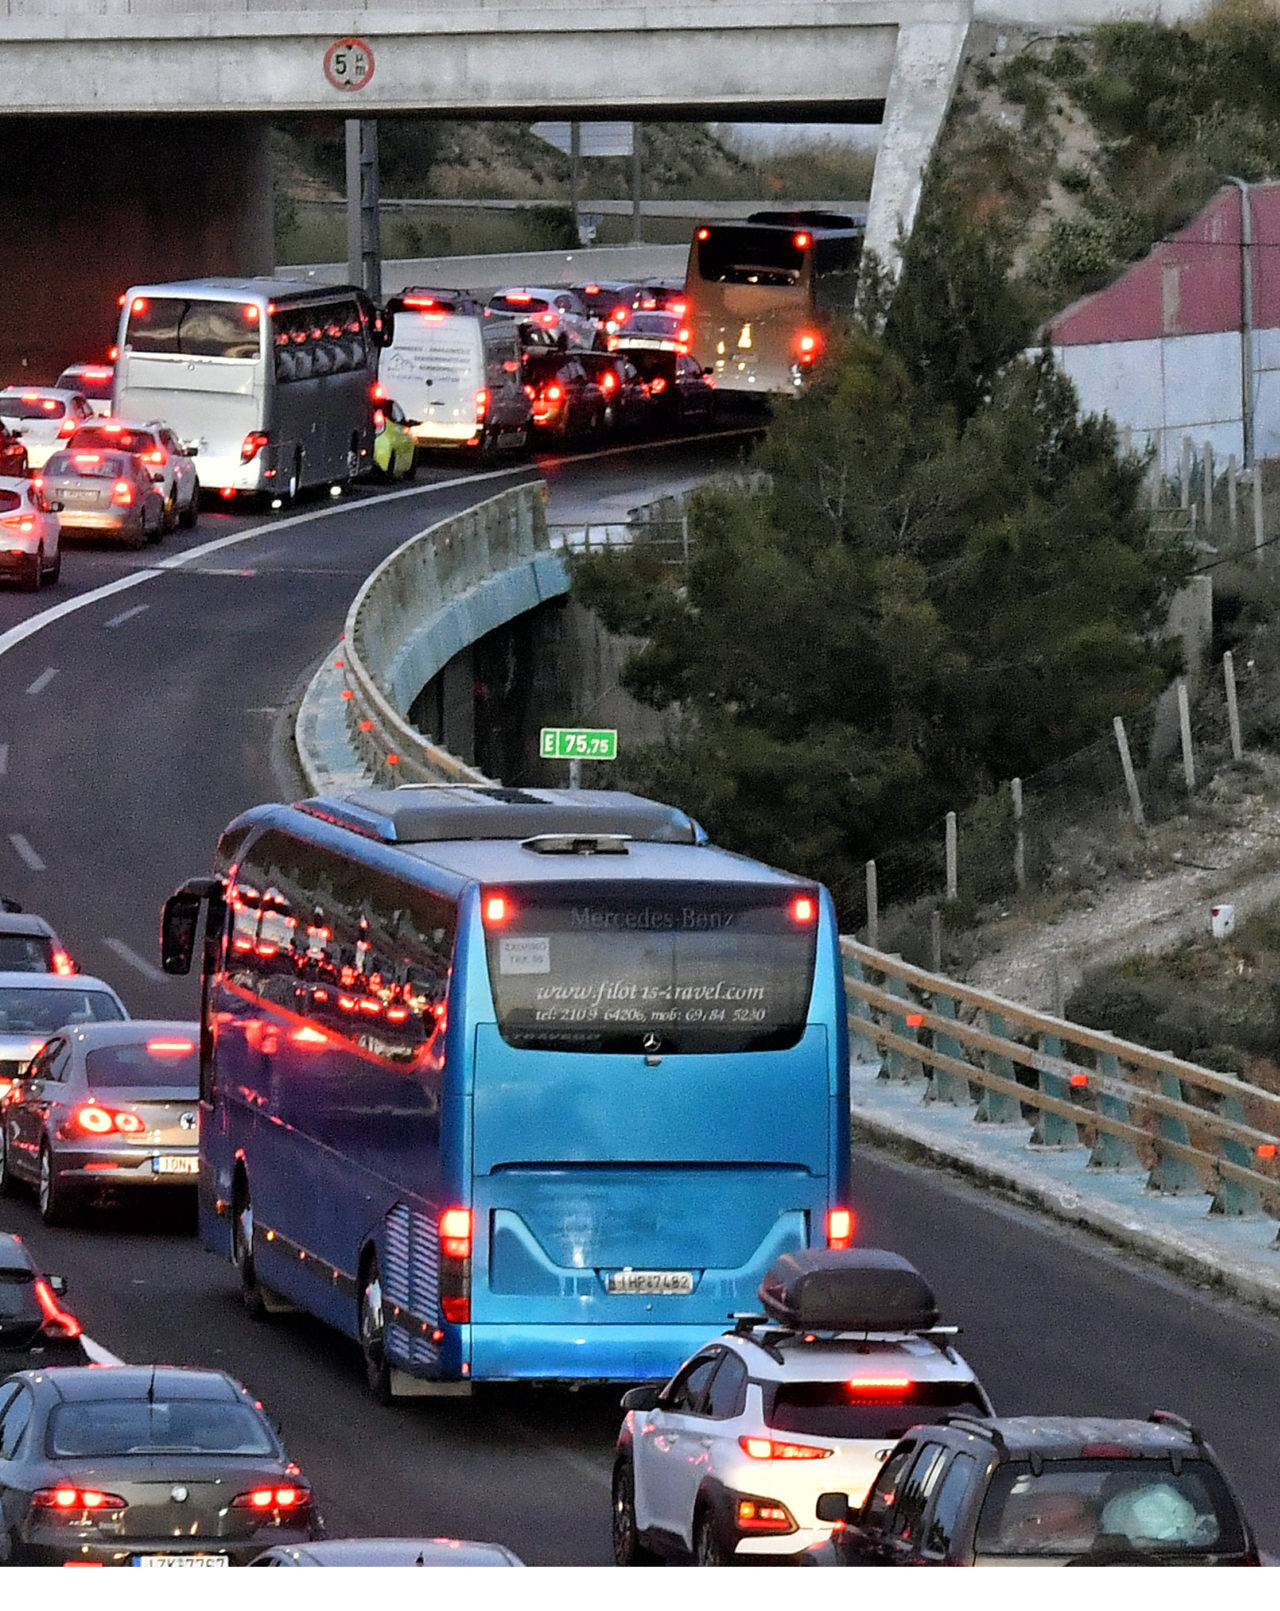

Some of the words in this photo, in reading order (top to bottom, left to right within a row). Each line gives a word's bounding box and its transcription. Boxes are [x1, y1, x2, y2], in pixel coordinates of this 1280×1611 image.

[335, 54, 347, 75] 5
[544, 734, 554, 752] E
[565, 734, 609, 755] 75,75
